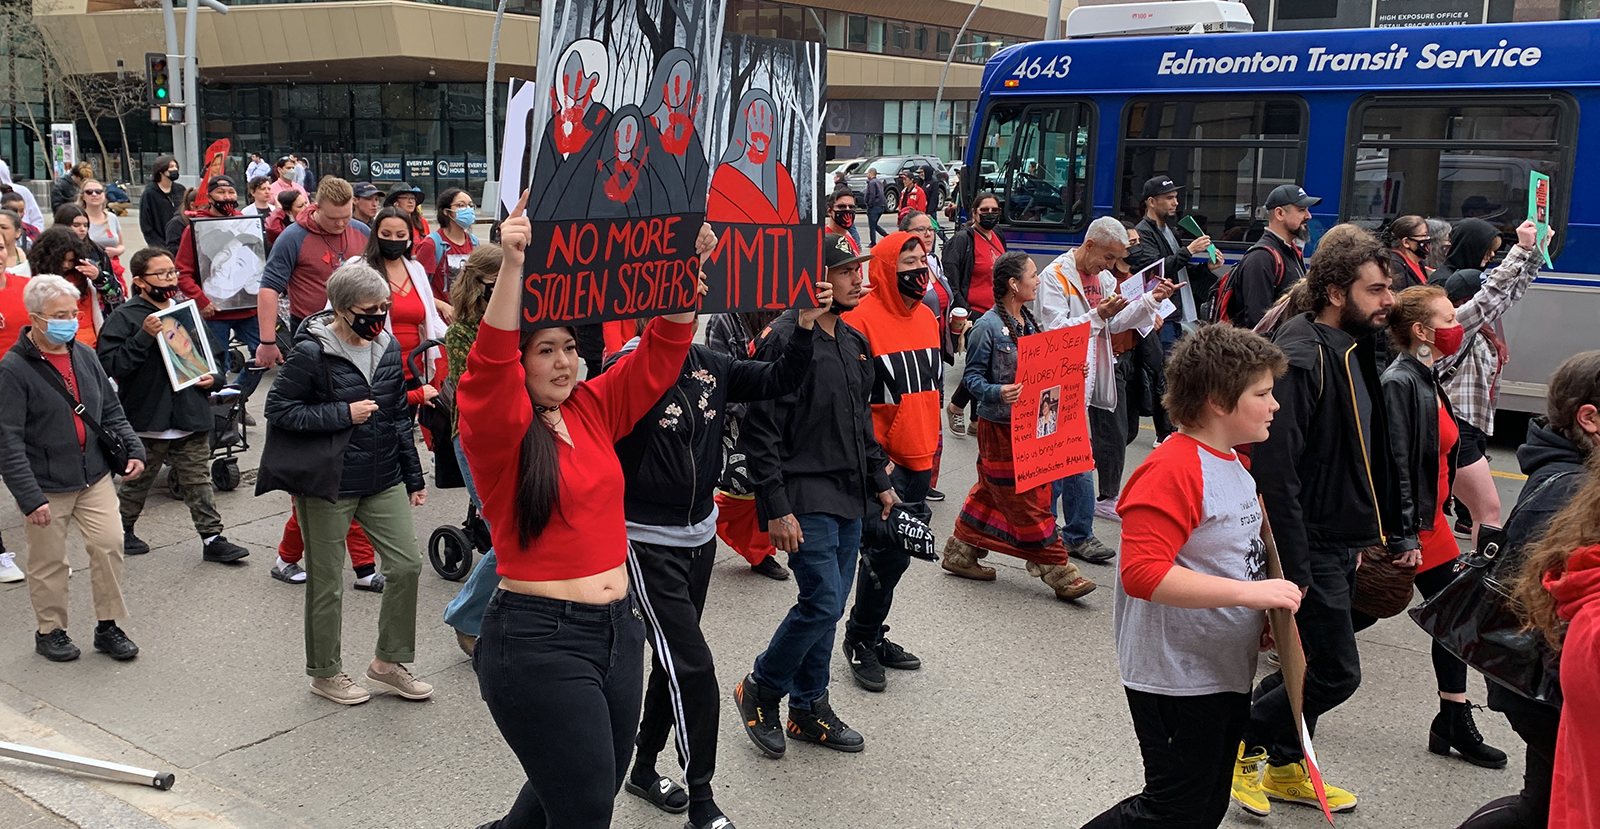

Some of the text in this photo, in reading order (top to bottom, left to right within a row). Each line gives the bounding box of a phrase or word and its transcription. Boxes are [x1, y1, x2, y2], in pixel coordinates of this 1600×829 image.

[1012, 55, 1072, 79] 4643
[1157, 39, 1542, 75] Edmonton Transit Service
[546, 216, 682, 269] NO MORE
[523, 256, 699, 323] STOLEN SISTERS
[1021, 345, 1041, 363] HAVE
[1062, 332, 1086, 350] SEEN
[1021, 365, 1058, 387] AUDREY
[1063, 411, 1078, 423] 2020
[1016, 450, 1029, 462] Help
[1066, 436, 1082, 444] home
